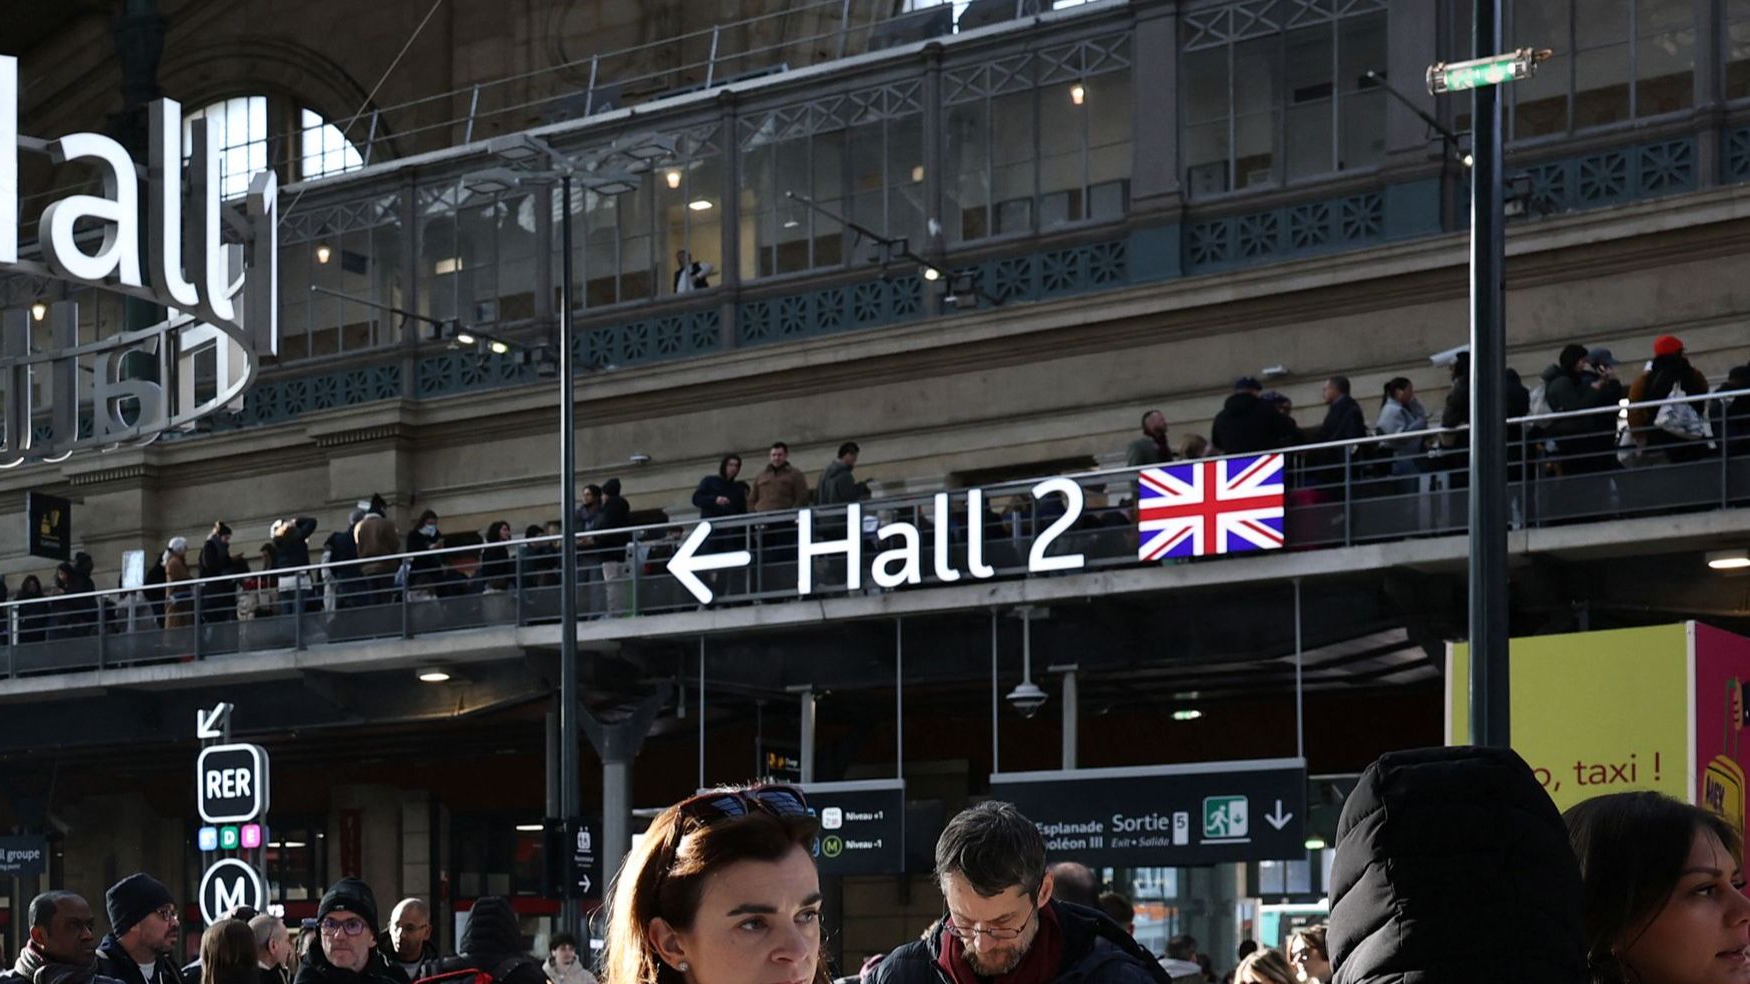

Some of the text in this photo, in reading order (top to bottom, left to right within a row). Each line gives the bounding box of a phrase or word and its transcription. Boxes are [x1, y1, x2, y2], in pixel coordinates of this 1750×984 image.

[796, 477, 1086, 595] Hall 2
[1572, 753, 1637, 786] taxi
[1654, 751, 1661, 782] !
[206, 768, 251, 800] RER
[845, 811, 873, 821] Niveau
[1112, 813, 1186, 833] Sortie 5
[1035, 820, 1104, 838] Esplanade
[224, 830, 236, 846] D
[845, 839, 873, 849] Niveau
[1046, 837, 1087, 850] oléon
[6, 849, 41, 863] groupe
[214, 876, 246, 914] M
[266, 904, 285, 918] YS
